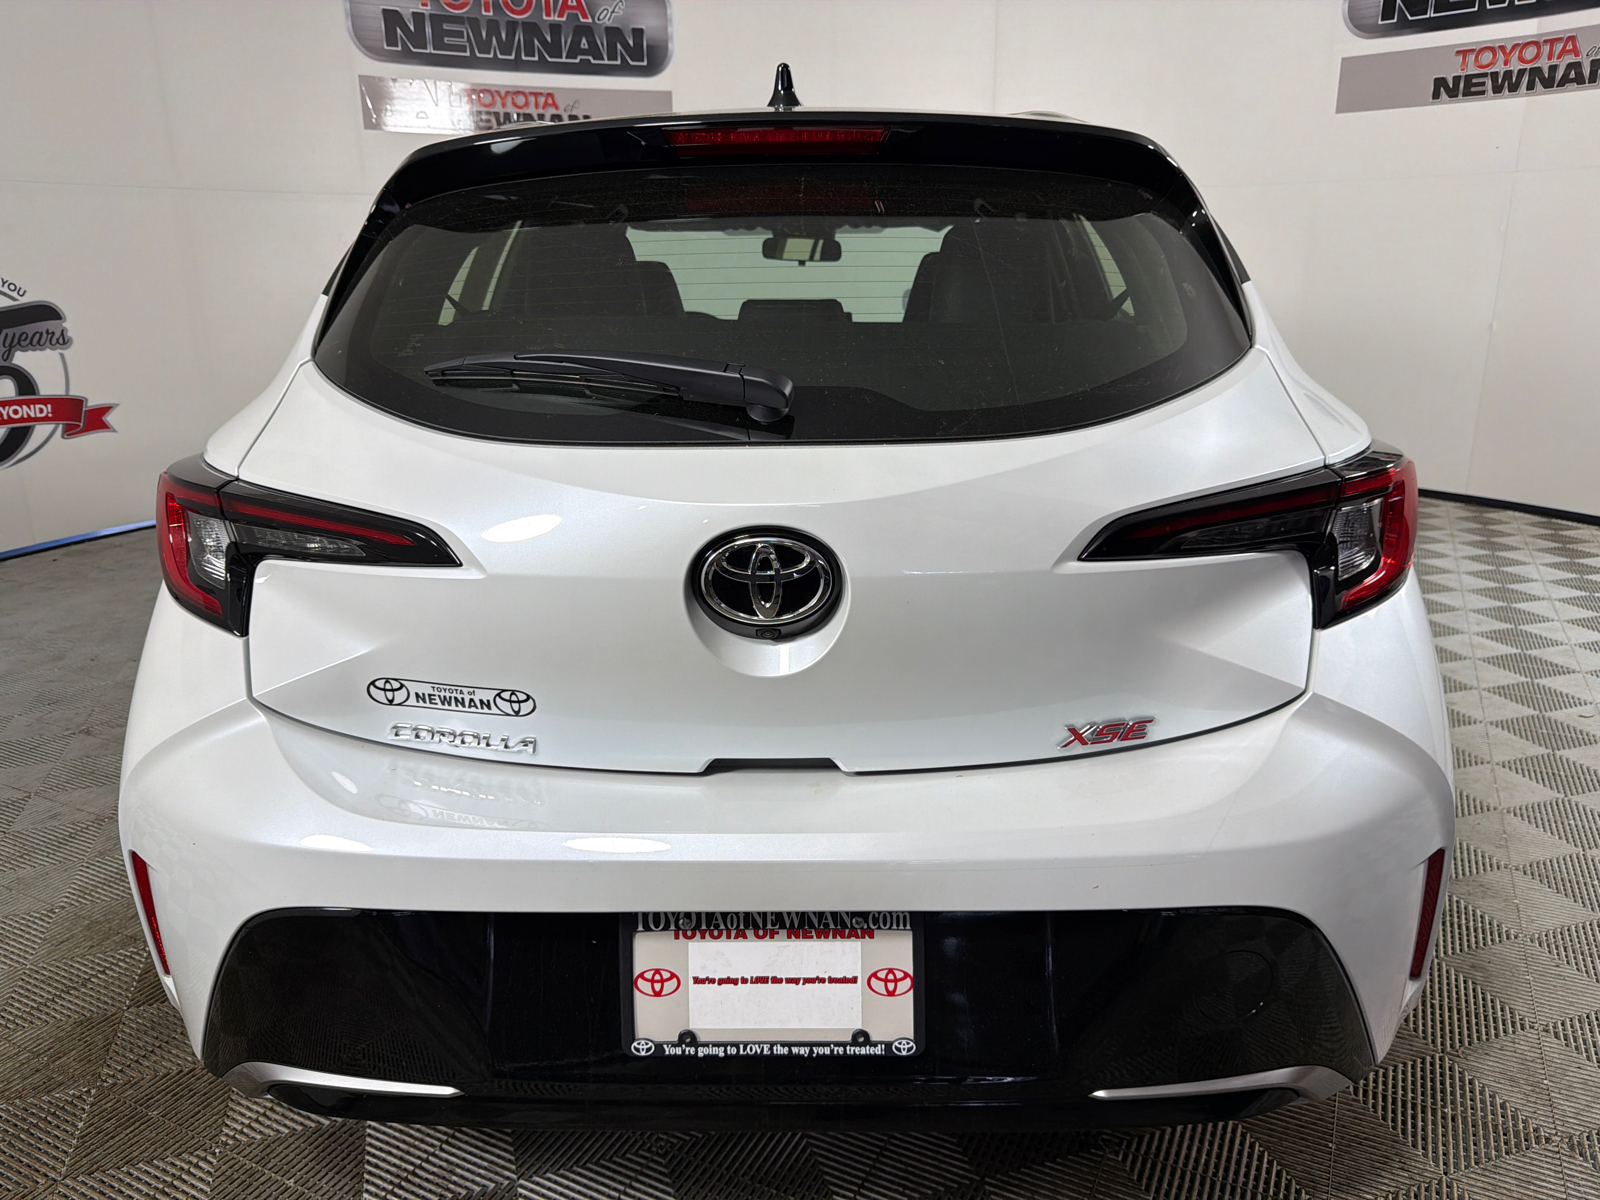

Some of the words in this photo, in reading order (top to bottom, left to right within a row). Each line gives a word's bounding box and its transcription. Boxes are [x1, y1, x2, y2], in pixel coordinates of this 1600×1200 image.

[595, 0, 626, 24] of
[381, 7, 648, 66] NEWNAN
[1454, 34, 1581, 72] TOYOTA
[463, 88, 560, 111] TOYOTA
[0, 277, 27, 298] YOU
[2, 328, 70, 362] years
[414, 692, 492, 711] NEWNAN
[431, 686, 465, 696] TOYOTA
[388, 722, 538, 755] COROLLA
[1057, 718, 1155, 749] XSE
[673, 929, 749, 940] TOYOTA
[753, 929, 780, 940] OF
[786, 928, 875, 940] NEWNAN
[663, 1044, 695, 1055] You're
[697, 1044, 725, 1057] going
[727, 1045, 737, 1055] to
[739, 1044, 770, 1055] LOVE
[773, 1044, 789, 1055] the
[791, 1046, 810, 1057] way
[812, 1044, 844, 1057] you're
[846, 1044, 885, 1055] treated!
